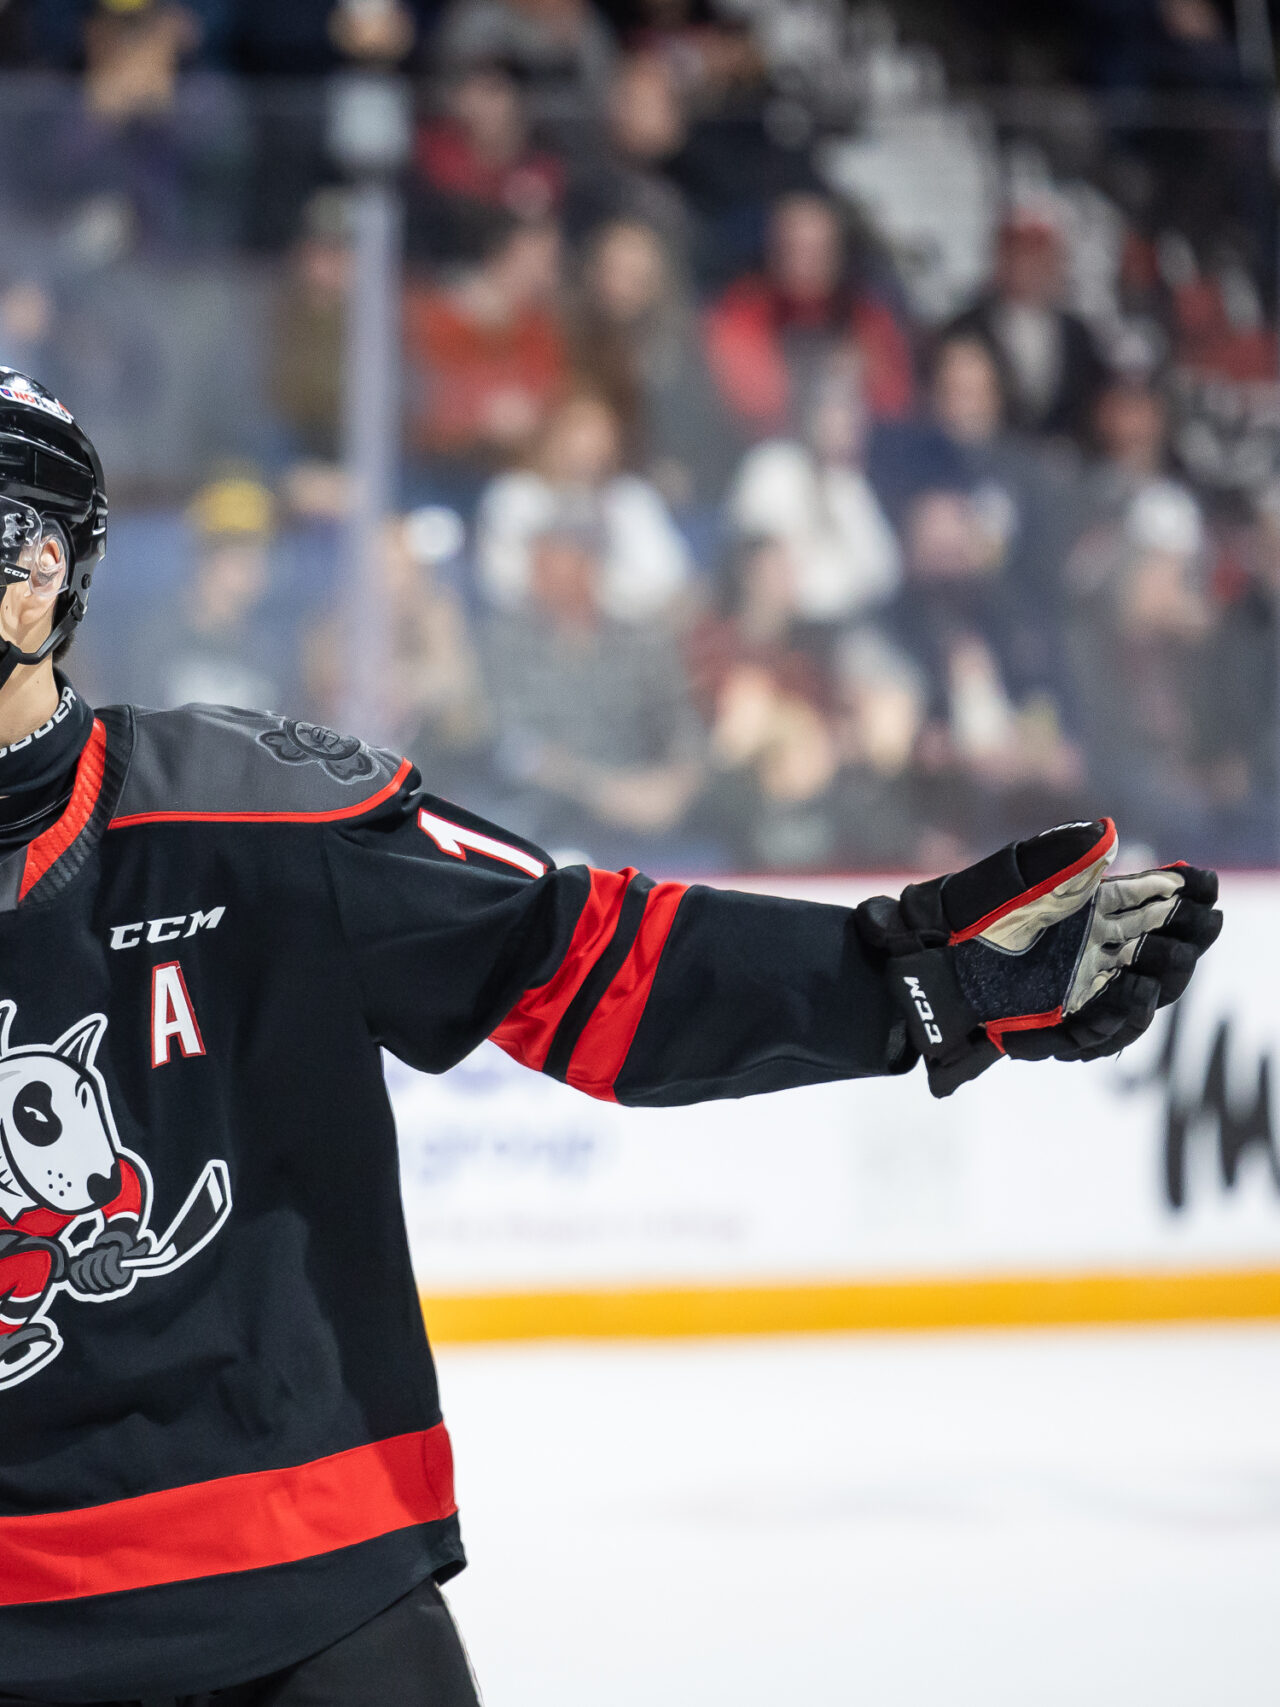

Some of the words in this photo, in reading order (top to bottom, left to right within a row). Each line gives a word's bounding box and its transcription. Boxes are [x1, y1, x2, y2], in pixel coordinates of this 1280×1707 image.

[3, 566, 29, 580] CCM
[109, 906, 227, 951] CCM
[151, 960, 207, 1069] A
[903, 976, 943, 1045] CCM
